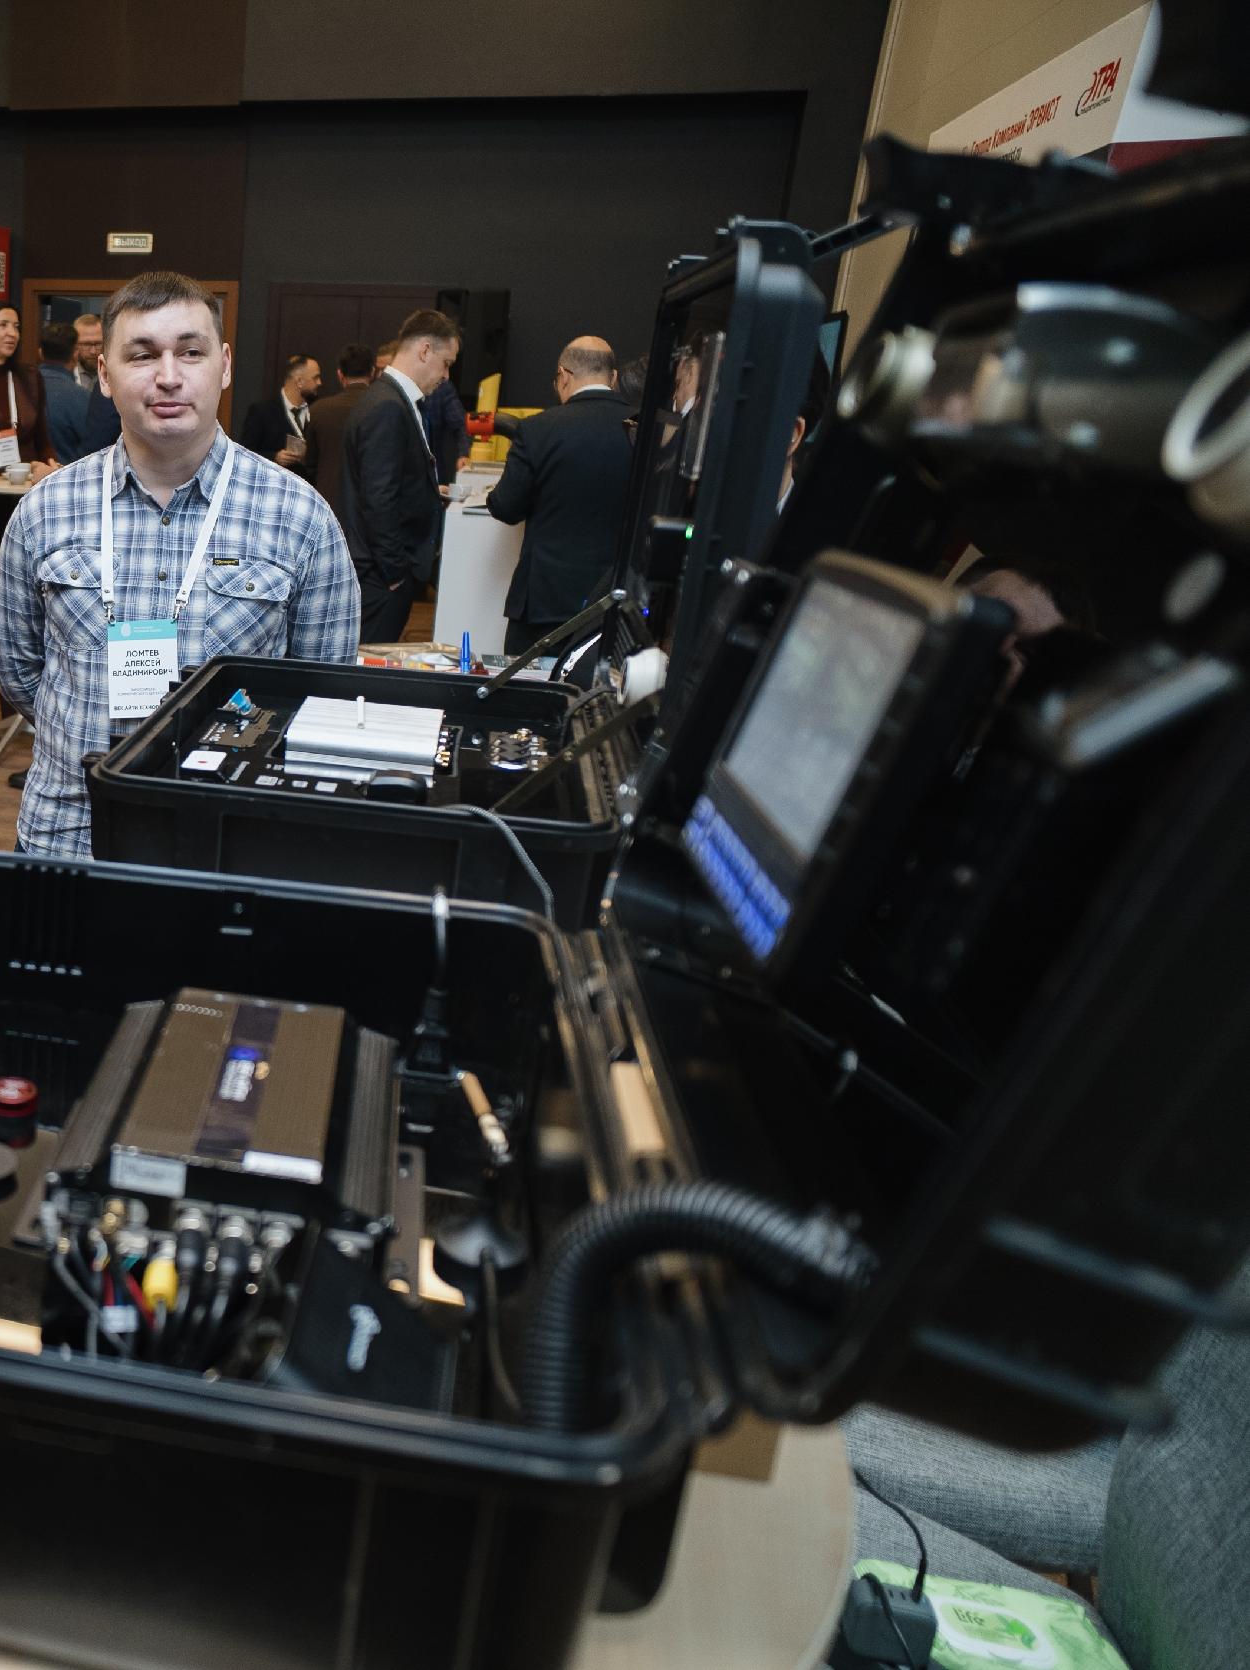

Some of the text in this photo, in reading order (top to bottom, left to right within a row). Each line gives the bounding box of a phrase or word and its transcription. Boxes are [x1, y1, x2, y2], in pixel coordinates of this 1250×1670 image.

[113, 237, 147, 248] ВЫХОД
[125, 658, 160, 667] АЛЕКСЕЙ
[113, 668, 172, 676] ВЛАДИМИРОВИЧ
